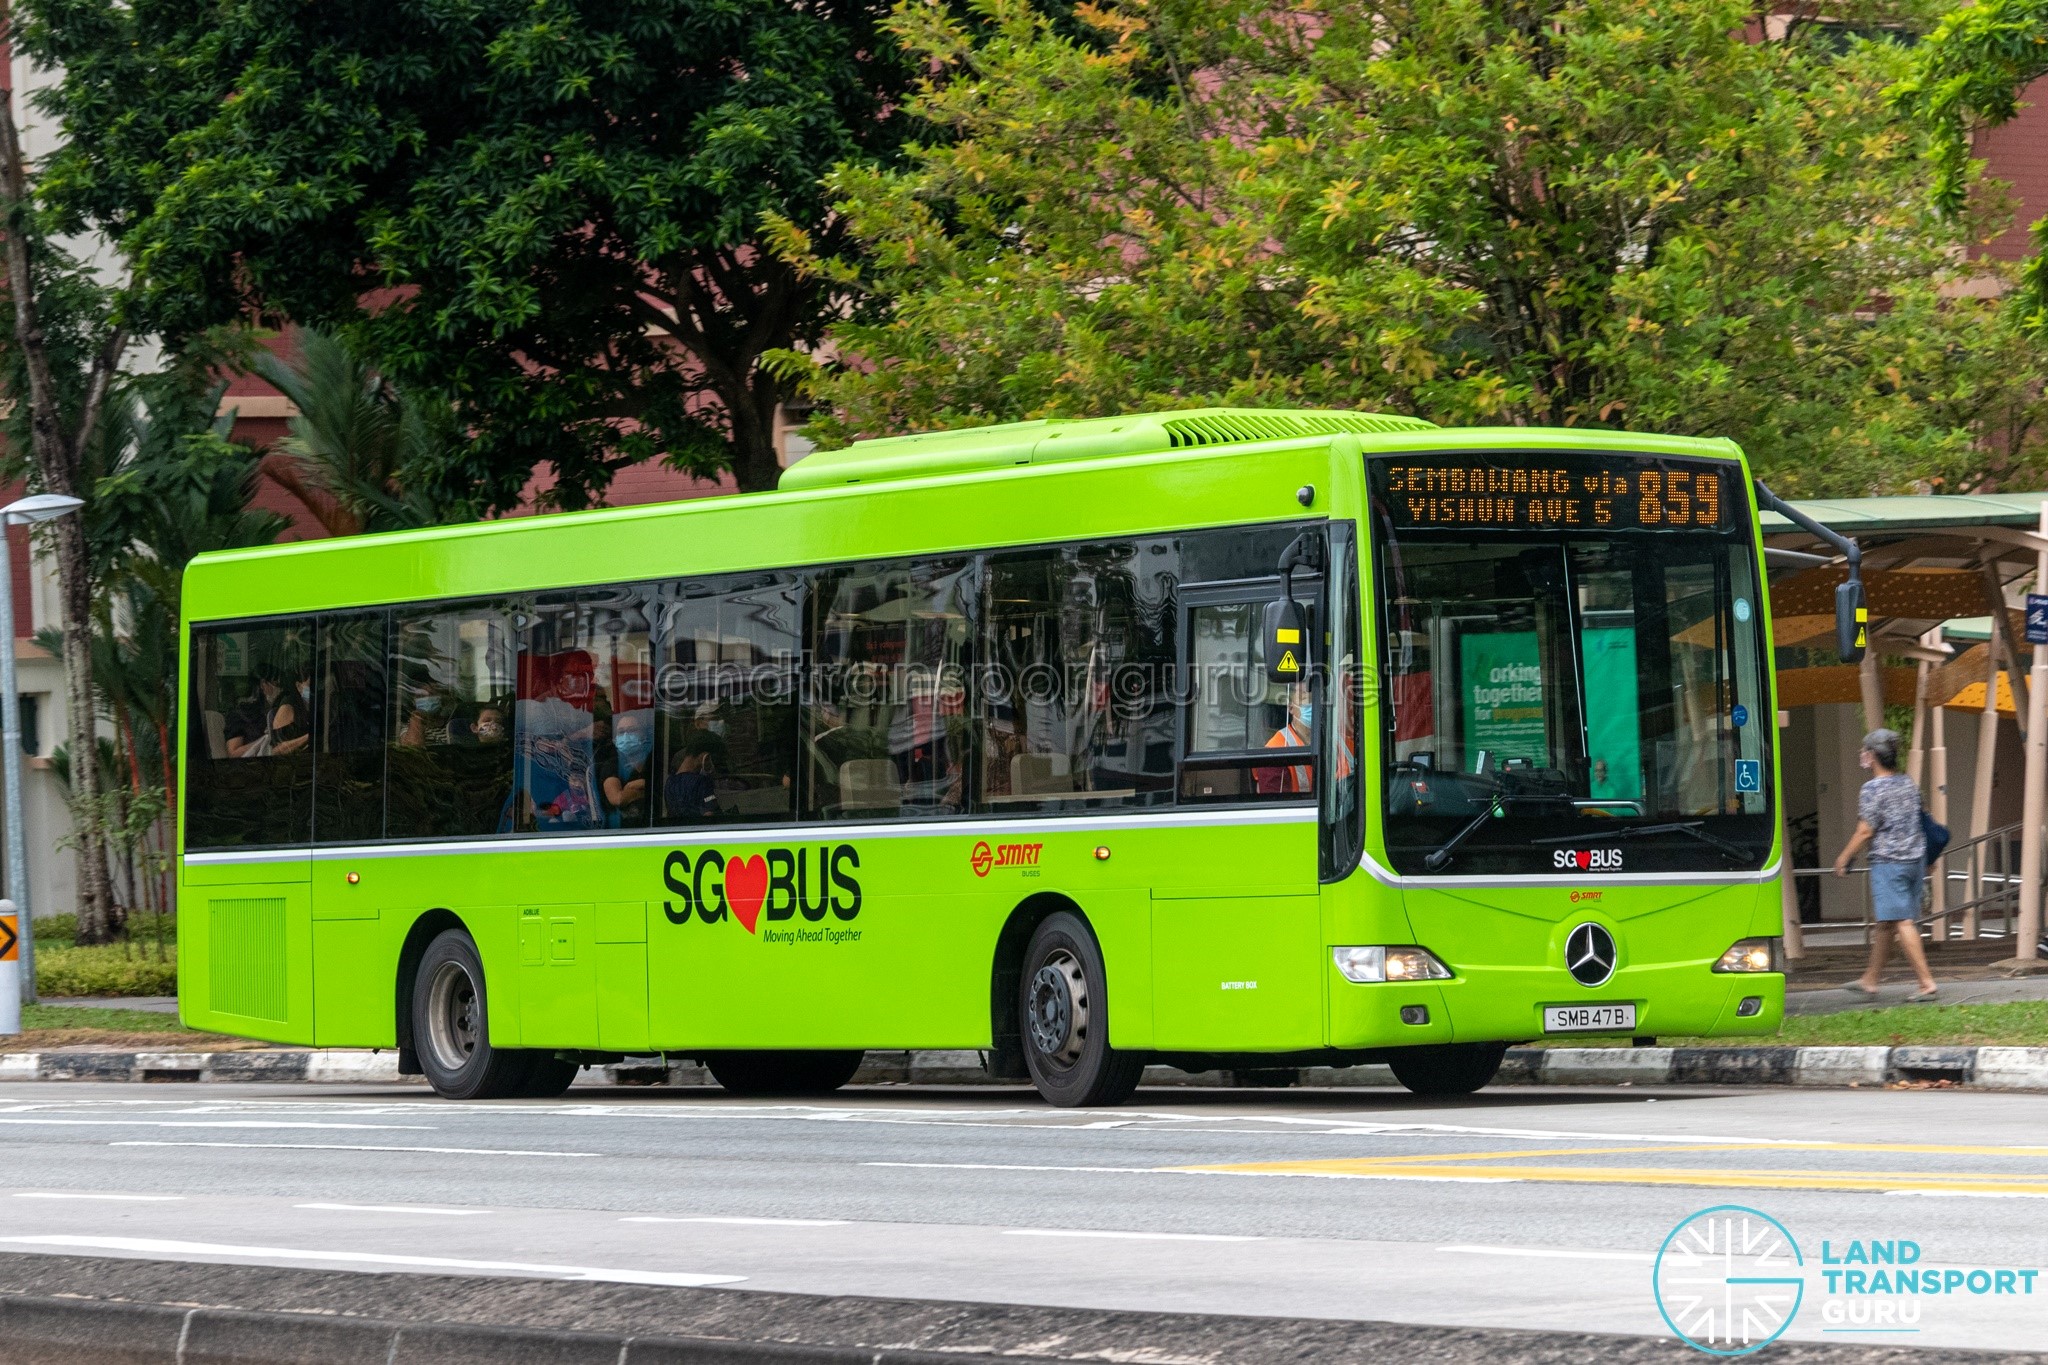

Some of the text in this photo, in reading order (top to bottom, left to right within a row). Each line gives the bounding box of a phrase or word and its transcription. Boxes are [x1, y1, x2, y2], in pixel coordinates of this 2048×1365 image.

[1388, 467, 1628, 494] SEMBAWANG via
[1638, 471, 1718, 525] 859
[1408, 497, 1515, 522] YISHUN
[1528, 499, 1580, 523] AVE
[1474, 683, 1542, 707] together
[994, 843, 1043, 865] SMRT
[1021, 870, 1041, 878] BUSES
[763, 927, 863, 946] Moving Ahead Together
[1221, 981, 1258, 990] BATTERY BOX
[1557, 1008, 1624, 1027] SMB47B
